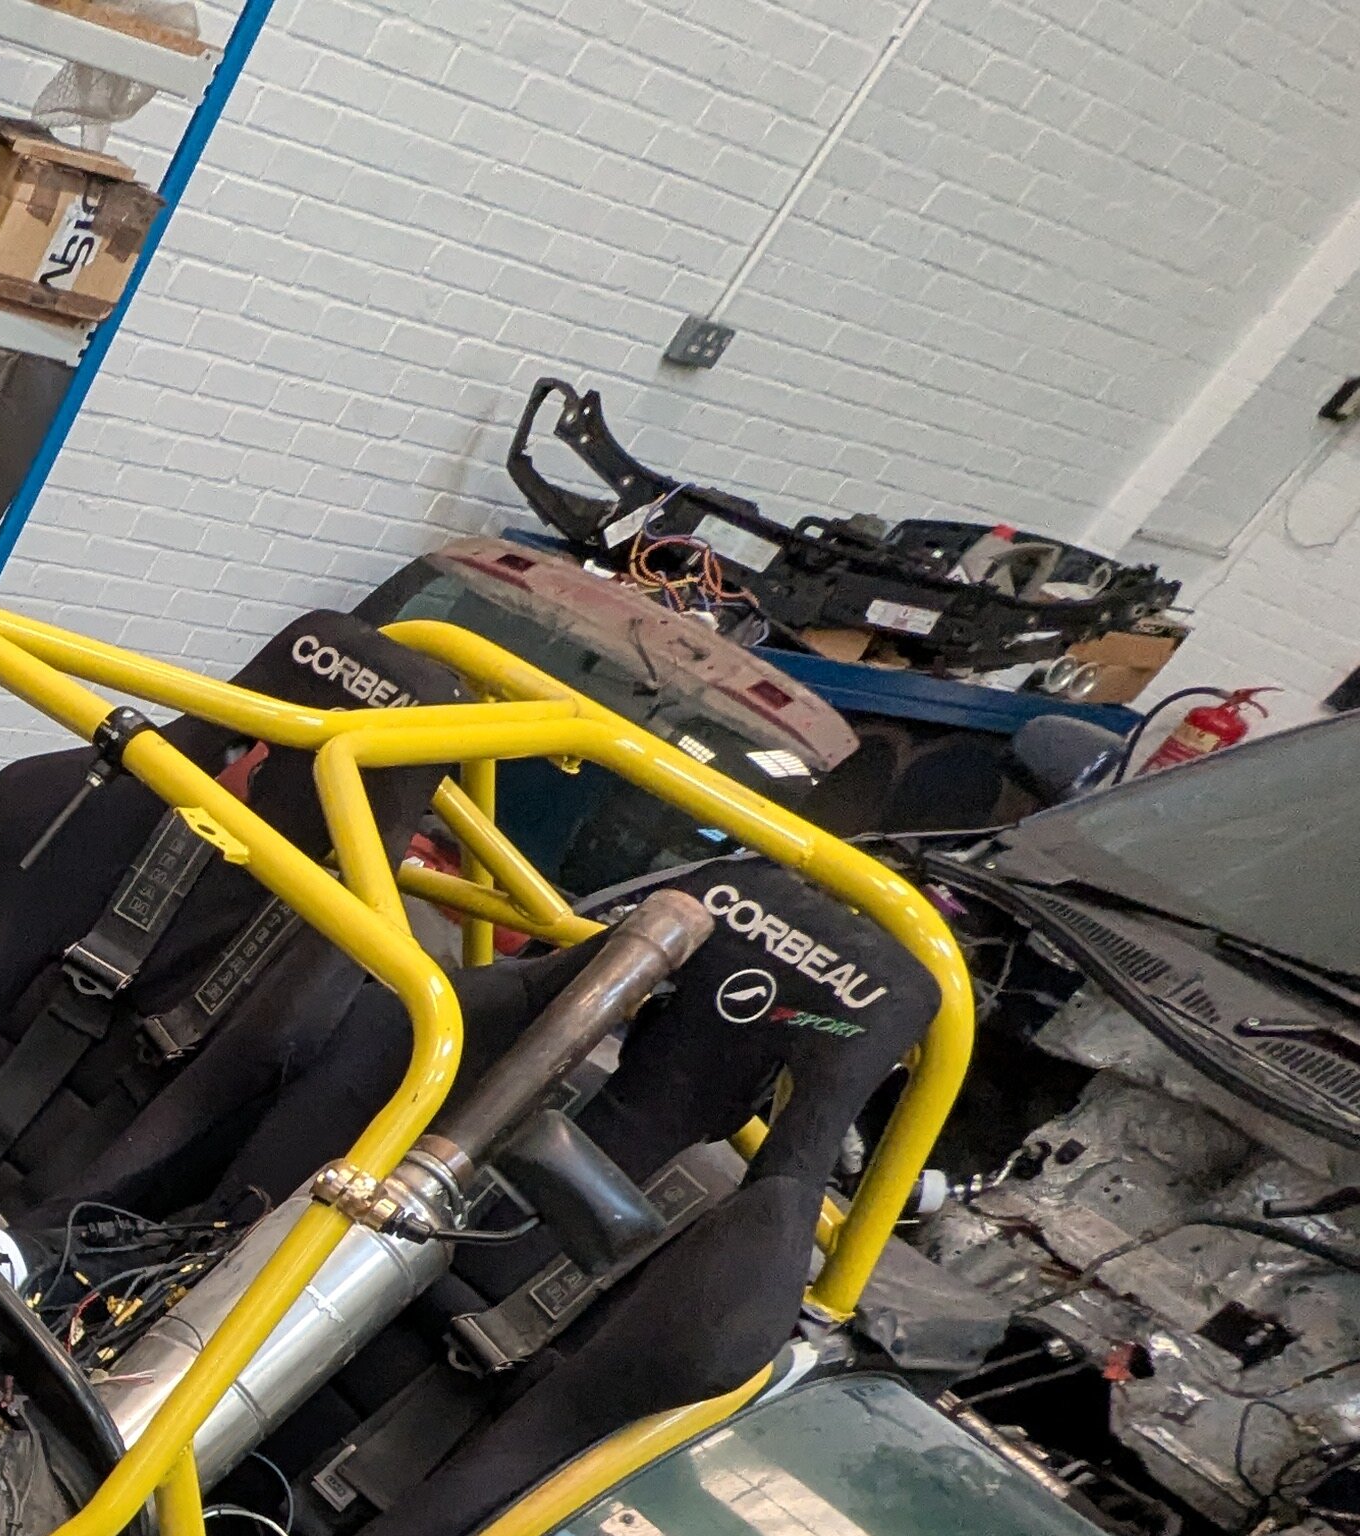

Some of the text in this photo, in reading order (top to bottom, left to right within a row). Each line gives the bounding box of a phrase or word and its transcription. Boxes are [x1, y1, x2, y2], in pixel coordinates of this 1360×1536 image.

[292, 635, 420, 708] CORBEA
[703, 884, 890, 1009] CORBEAU
[788, 1011, 866, 1038] SPORT
